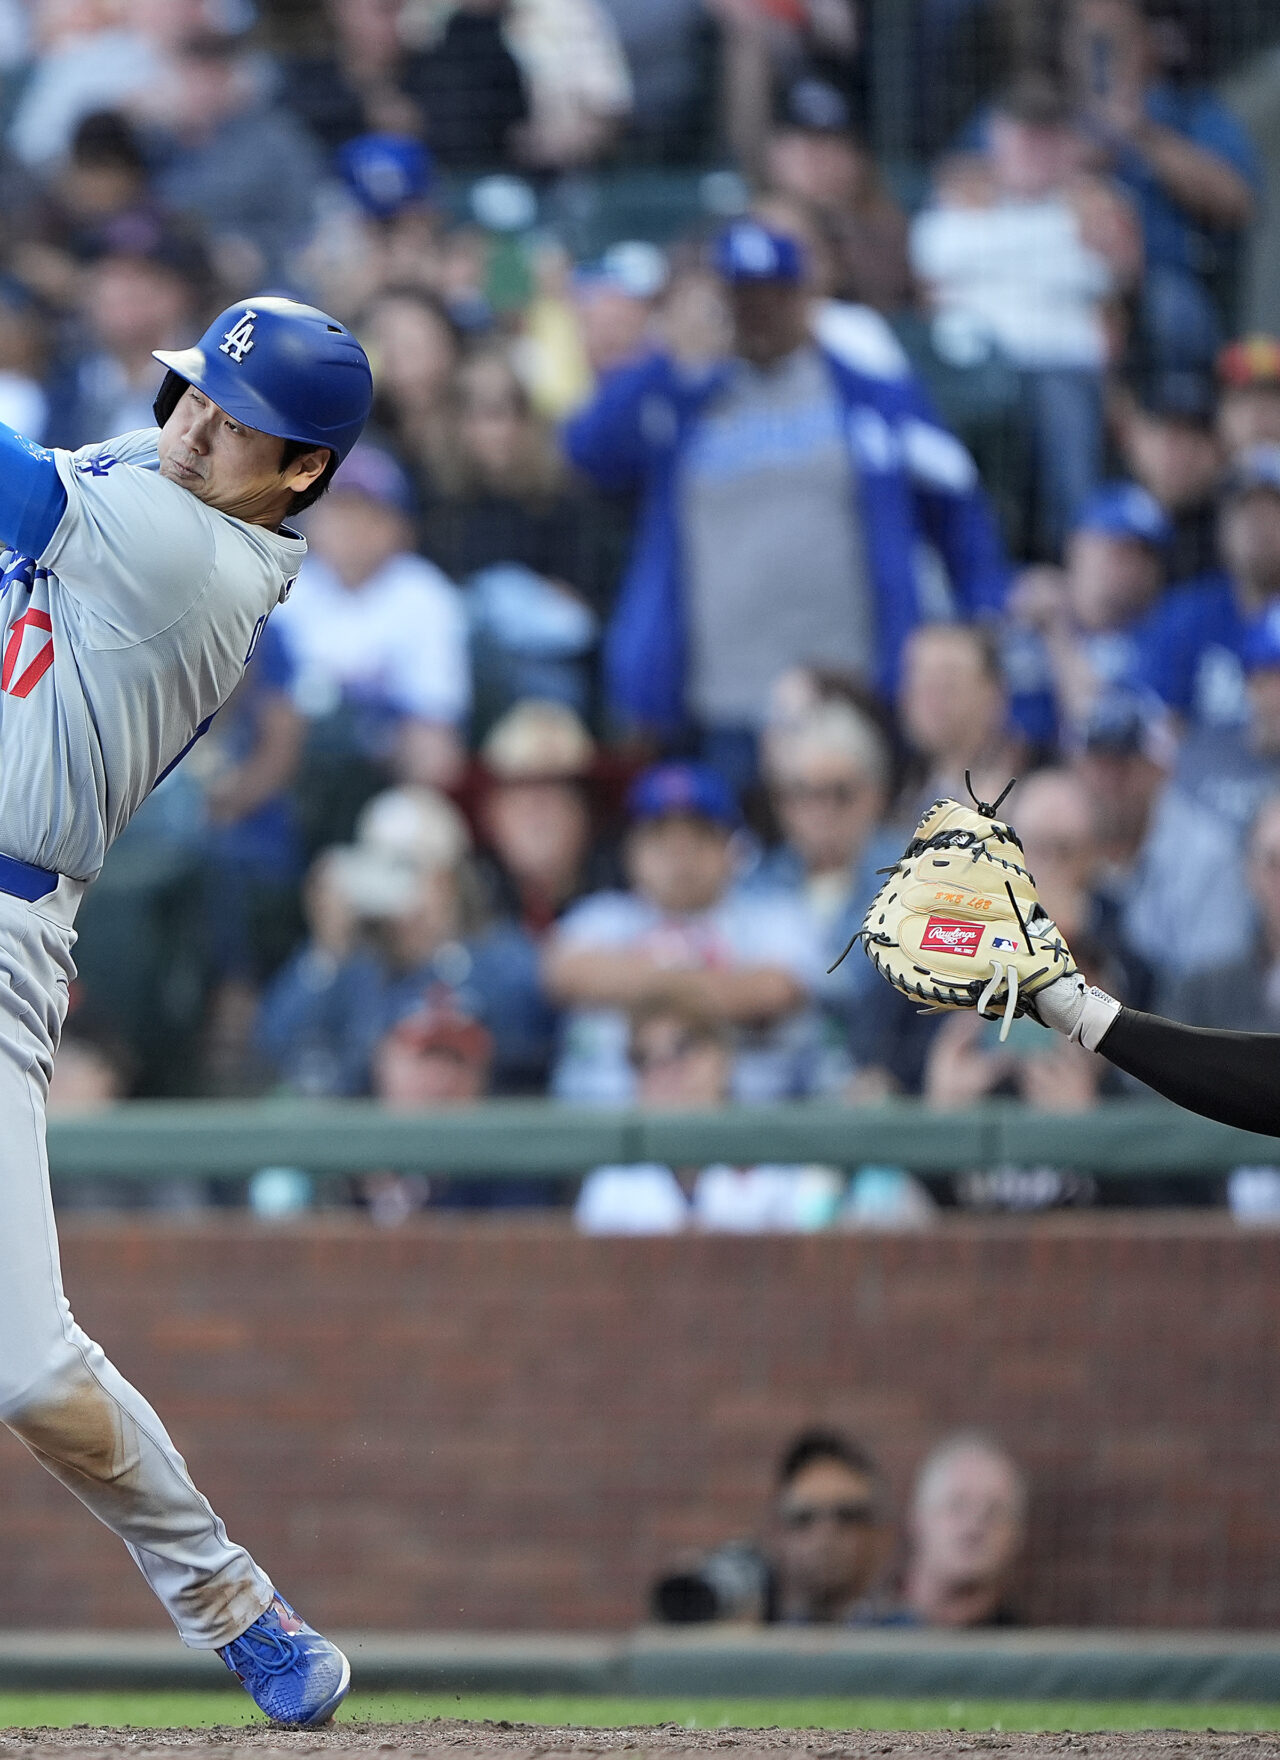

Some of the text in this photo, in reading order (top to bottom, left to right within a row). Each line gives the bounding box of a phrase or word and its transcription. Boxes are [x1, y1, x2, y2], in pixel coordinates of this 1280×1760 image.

[219, 310, 257, 362] LA
[1, 608, 55, 698] 17
[928, 927, 976, 943] Rawlings
